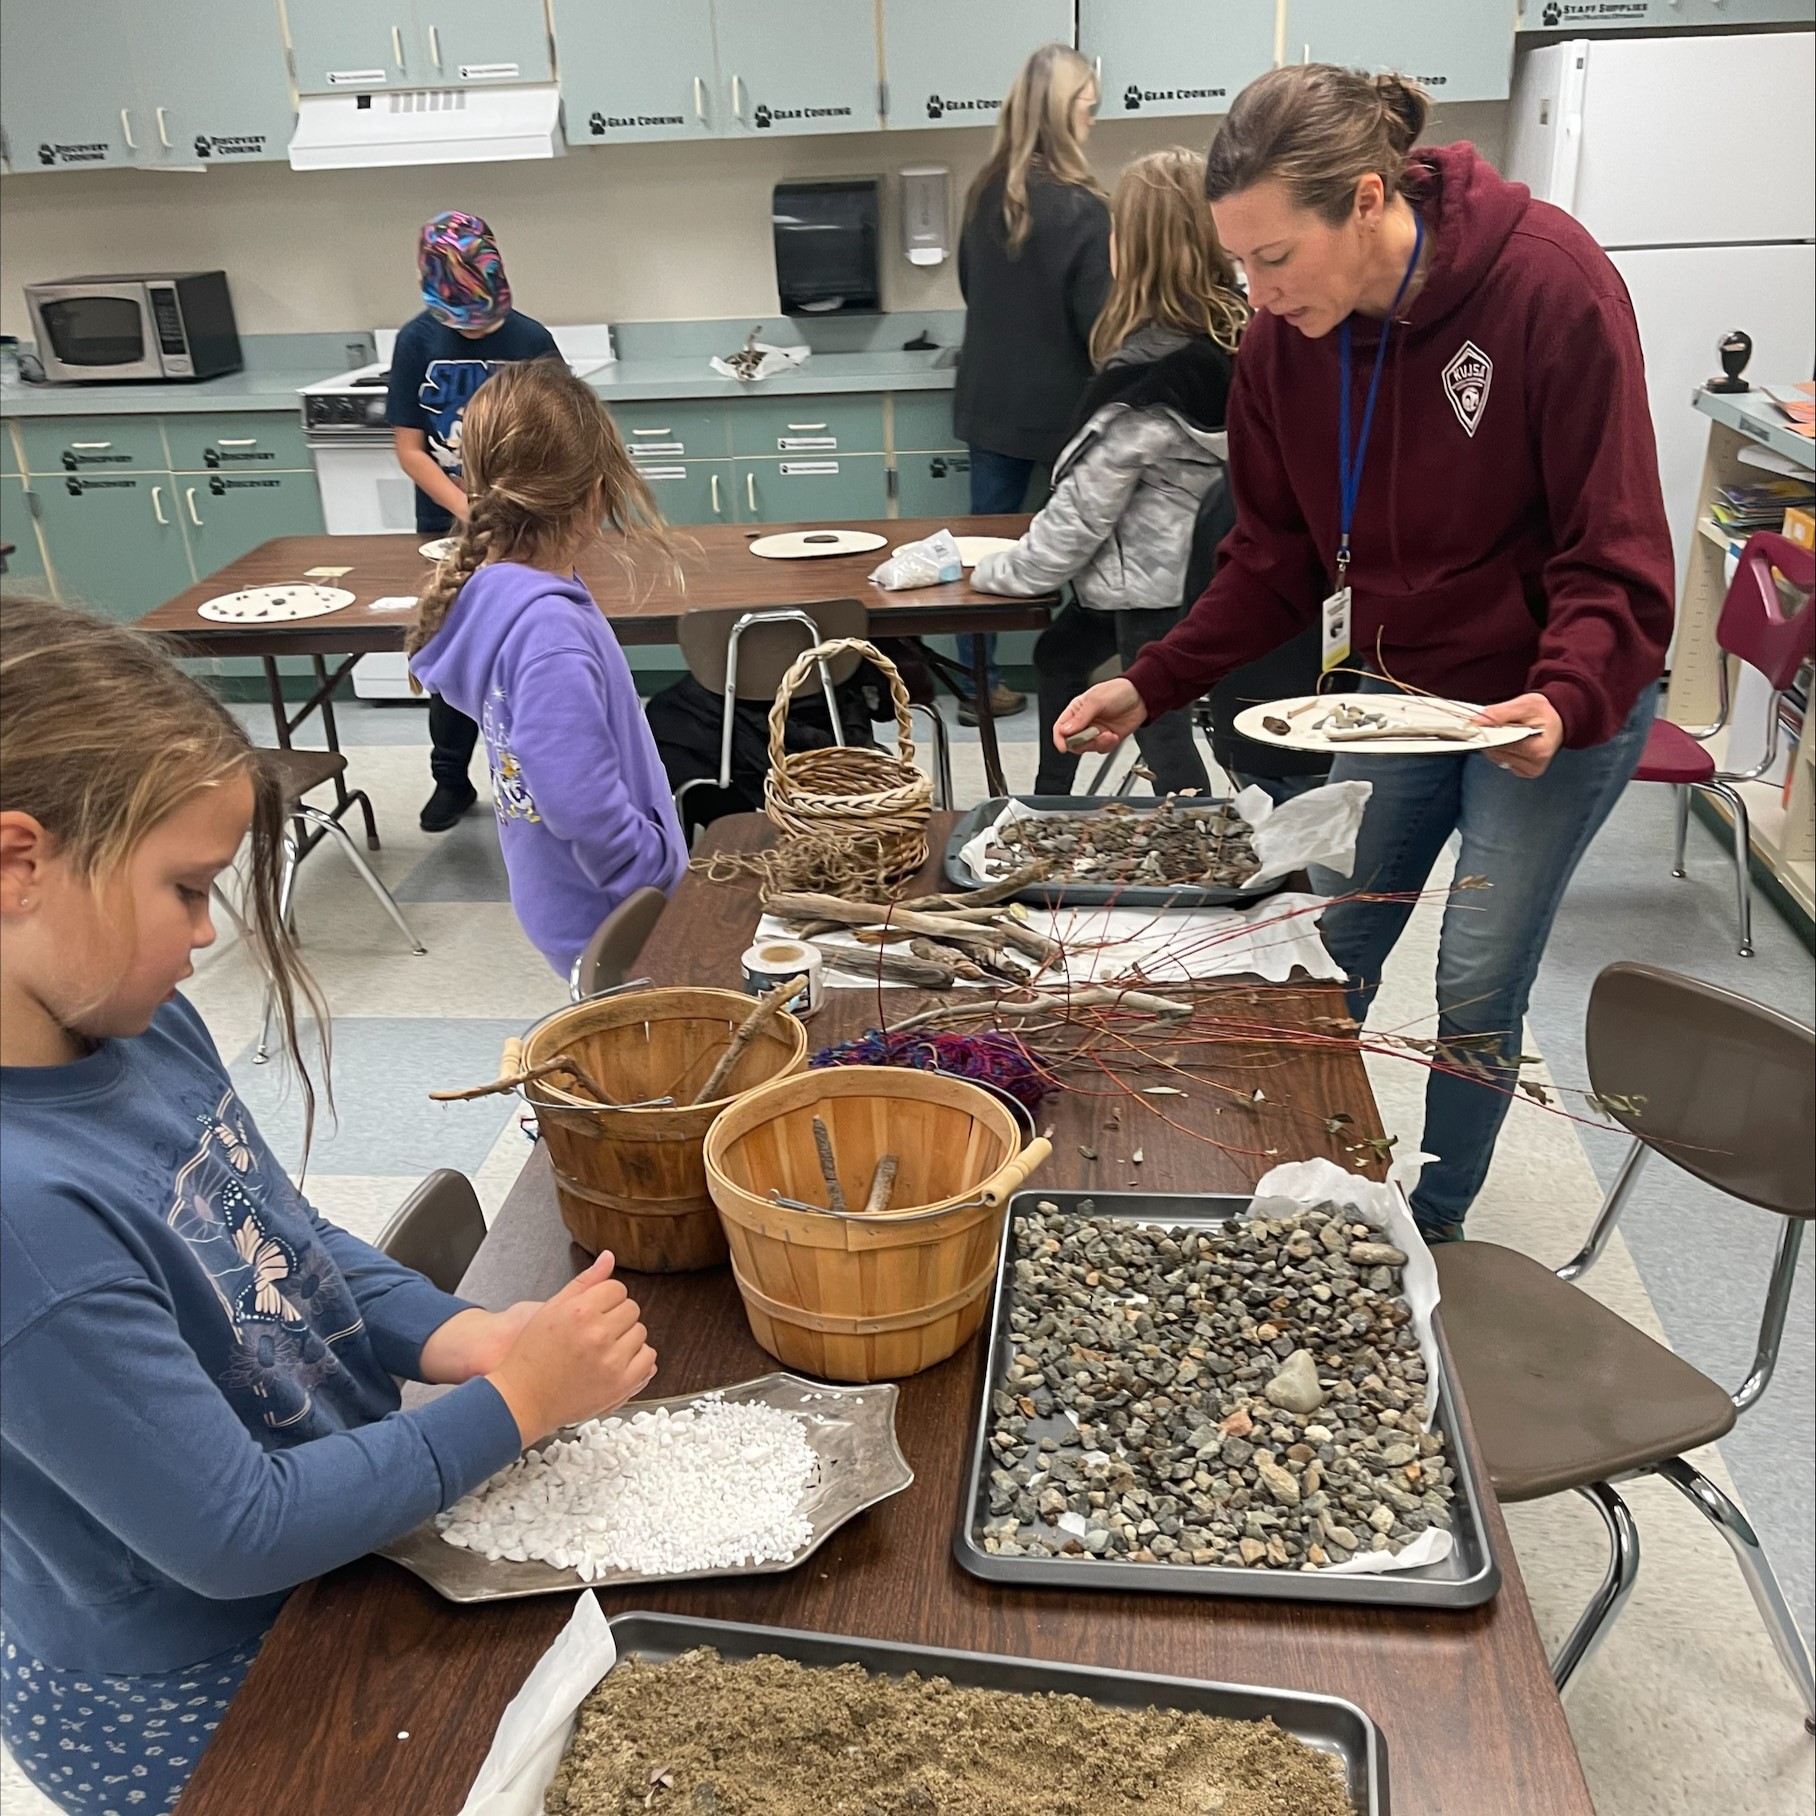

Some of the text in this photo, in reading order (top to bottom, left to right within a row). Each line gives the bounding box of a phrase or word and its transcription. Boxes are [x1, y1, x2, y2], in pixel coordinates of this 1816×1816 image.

[1563, 5, 1596, 14] STAFF
[1145, 88, 1226, 101] GEAR COOKING
[946, 101, 974, 110] GEAR
[774, 107, 852, 119] GEAR COOKING
[608, 116, 684, 127] GEAR COOKING
